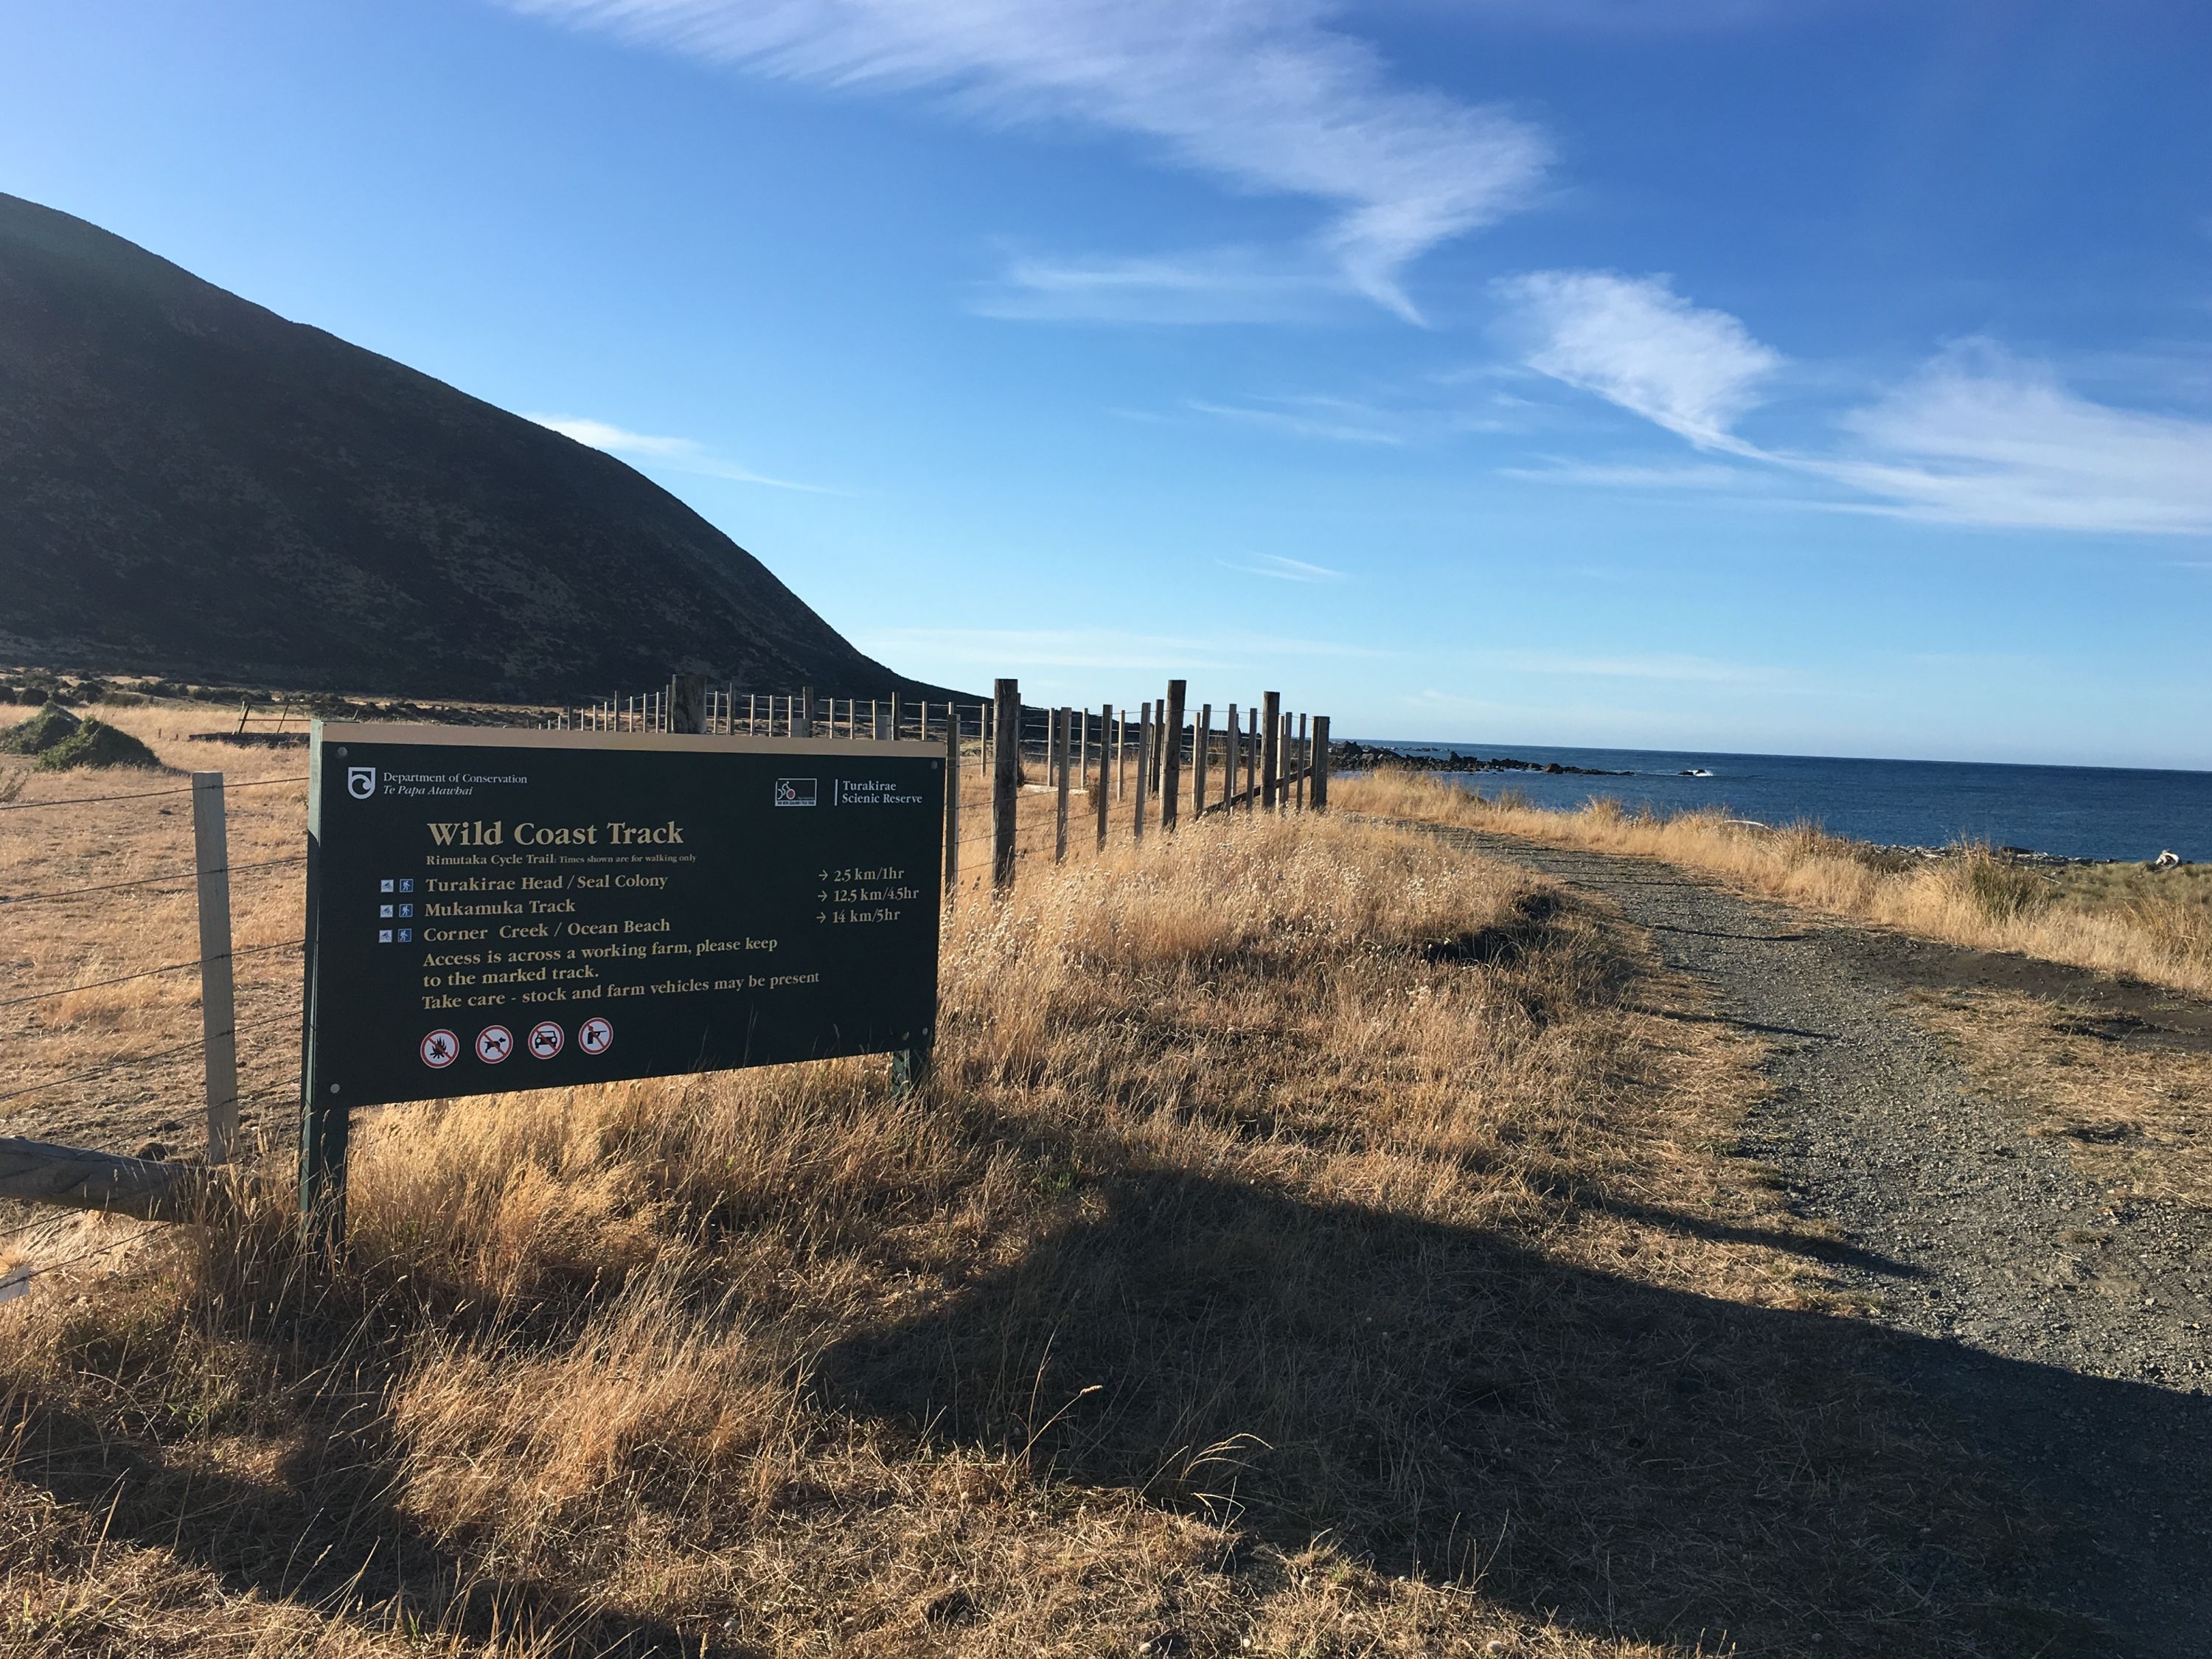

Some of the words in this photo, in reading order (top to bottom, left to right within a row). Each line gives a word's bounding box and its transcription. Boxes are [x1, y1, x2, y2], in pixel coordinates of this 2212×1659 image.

[383, 772, 445, 784] Department
[449, 773, 460, 782] of
[462, 773, 527, 783] Conservation
[843, 780, 896, 790] Turakirae
[383, 785, 395, 794] Te
[397, 786, 425, 796] Papa
[428, 786, 473, 796] Atawhai
[842, 793, 880, 803] Scienic
[883, 794, 922, 804] Reserve
[426, 821, 504, 846] Wild
[514, 822, 597, 845] Coast
[607, 820, 684, 844] Track
[426, 855, 487, 866] Rimutaka
[490, 854, 523, 866] Cycle
[587, 855, 613, 863] shown
[645, 854, 677, 863] walking
[679, 854, 697, 863] only
[834, 869, 851, 882] 2.5
[855, 867, 905, 880] km/1hr
[425, 877, 515, 892] Turakirae
[521, 876, 563, 890] Head
[567, 874, 575, 890] /
[577, 874, 610, 888] Seal
[615, 874, 669, 889] Colony
[834, 889, 857, 902] 12.5
[424, 900, 523, 917] Mukamuka
[529, 899, 576, 914] Track
[832, 909, 846, 923] 14
[850, 908, 900, 922] km/5hr
[423, 927, 489, 942] Corner
[499, 923, 549, 939] Creek
[554, 922, 562, 937] /
[567, 921, 618, 936] Ocean
[624, 918, 670, 933] Beach
[422, 953, 481, 967] Access
[487, 950, 501, 963] is
[508, 950, 561, 962] across
[566, 949, 576, 959] a
[581, 943, 647, 959] working
[651, 942, 692, 956] farm,
[696, 939, 740, 956] please
[745, 937, 778, 953] keep
[422, 975, 441, 987] to
[448, 971, 476, 986] the
[482, 967, 546, 984] marked
[552, 964, 599, 980] track.
[421, 994, 462, 1009] Take
[467, 994, 506, 1006] care
[522, 987, 566, 1003] stock
[571, 984, 602, 999] and
[606, 984, 645, 997] farm
[651, 978, 709, 993] vehicles
[714, 978, 745, 991] may
[748, 975, 765, 987] be
[770, 972, 819, 990] present
